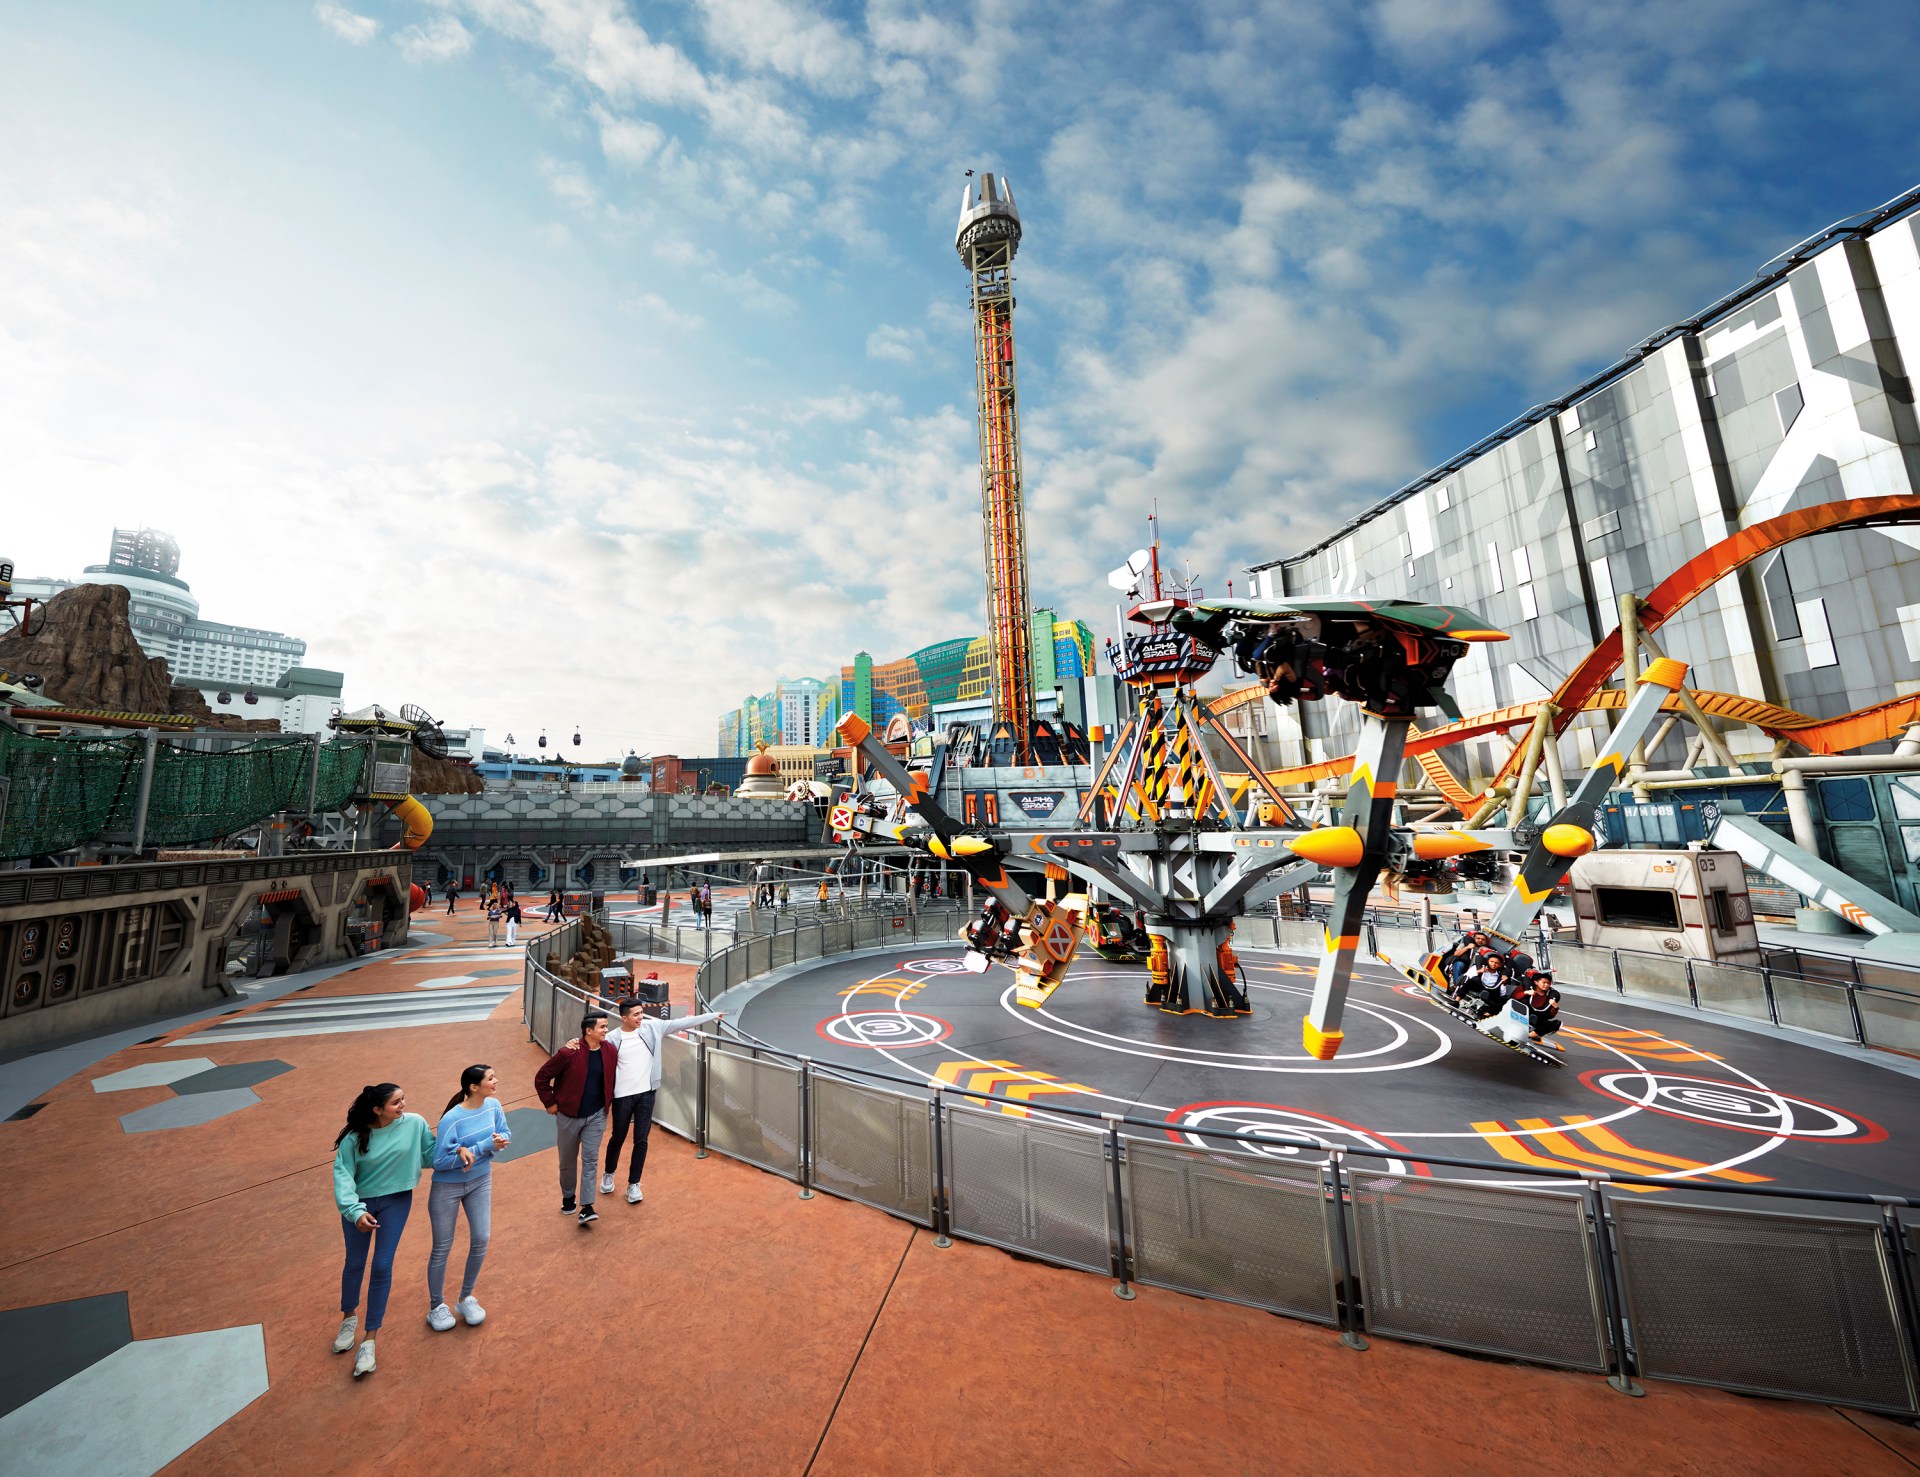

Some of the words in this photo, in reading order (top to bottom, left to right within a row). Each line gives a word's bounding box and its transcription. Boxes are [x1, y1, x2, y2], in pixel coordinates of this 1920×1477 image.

[1141, 641, 1178, 653] ALPHA
[1142, 648, 1178, 659] SPACE
[1023, 767, 1046, 779] 01
[1653, 865, 1675, 873] 03
[1699, 858, 1716, 872] 03
